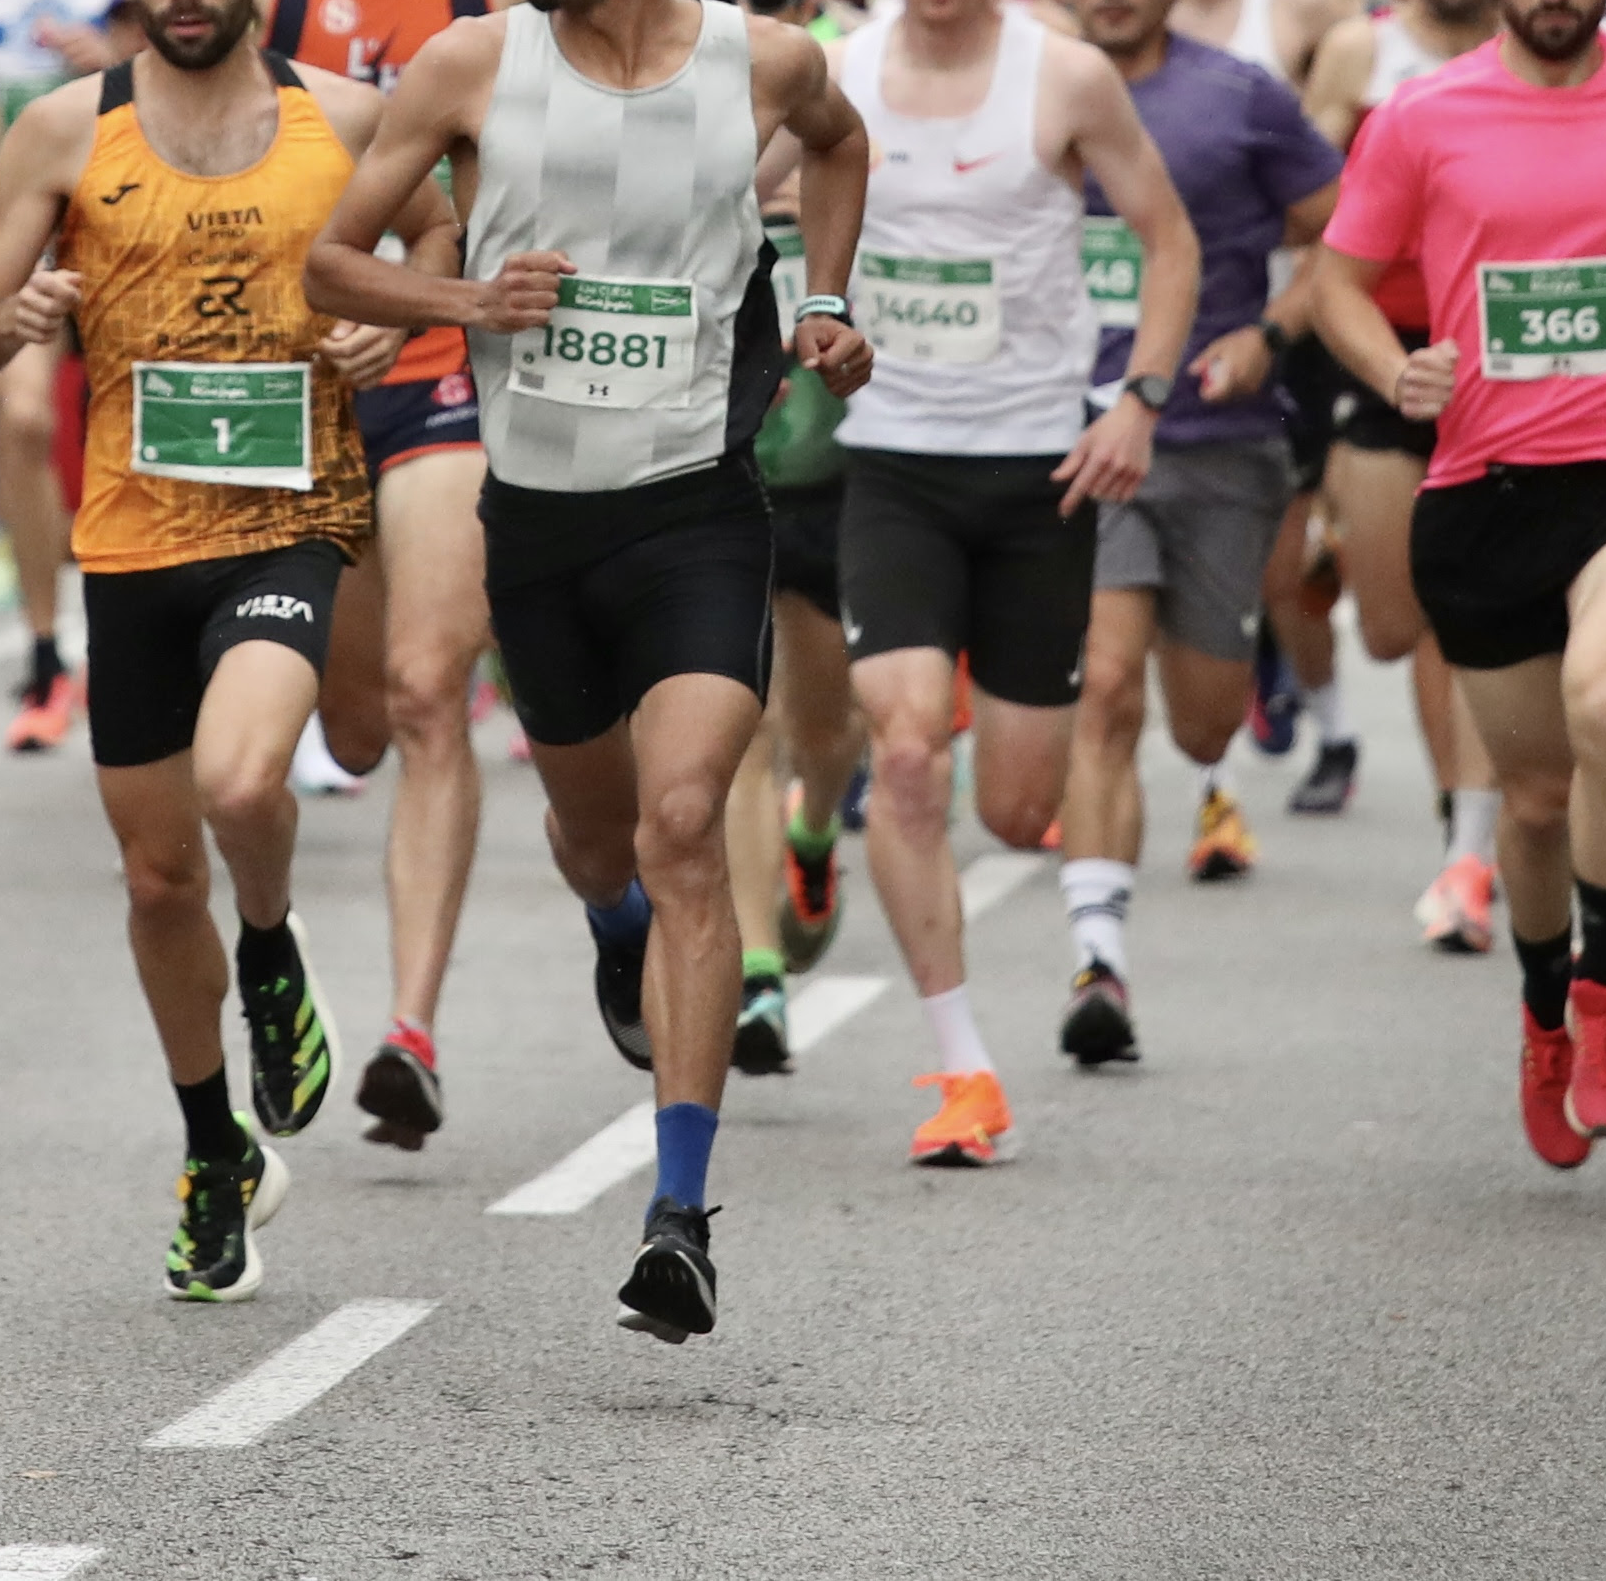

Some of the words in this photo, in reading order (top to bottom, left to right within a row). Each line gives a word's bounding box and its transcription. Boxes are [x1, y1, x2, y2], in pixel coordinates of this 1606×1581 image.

[1520, 306, 1600, 345] 366
[543, 323, 667, 369] 18881
[211, 417, 231, 454] 1
